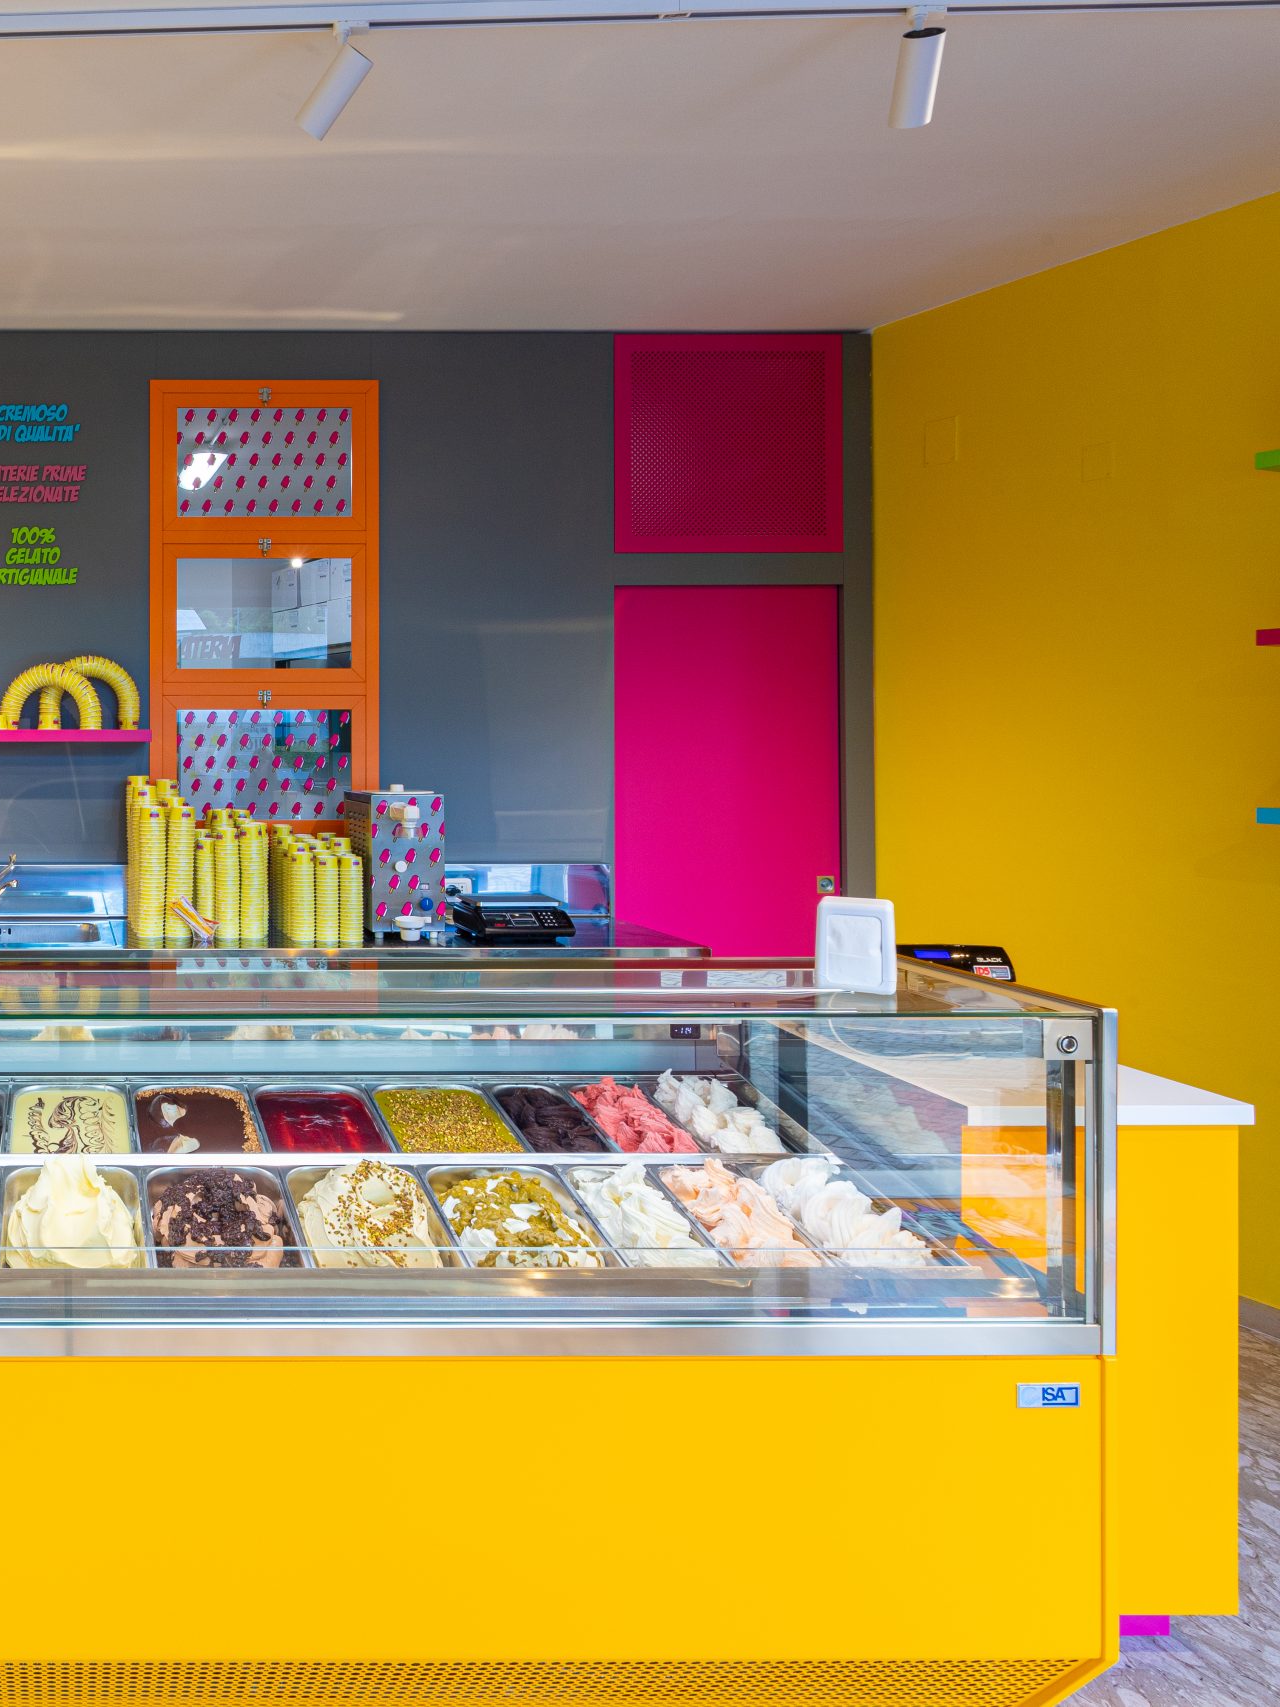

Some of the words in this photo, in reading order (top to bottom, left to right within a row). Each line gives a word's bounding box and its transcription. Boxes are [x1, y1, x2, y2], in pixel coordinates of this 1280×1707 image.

[14, 424, 80, 443] QUALITA'
[42, 465, 87, 482] PRIME
[11, 527, 56, 545] 100%
[5, 547, 61, 565] GELATO
[1042, 1387, 1066, 1401] ISA
